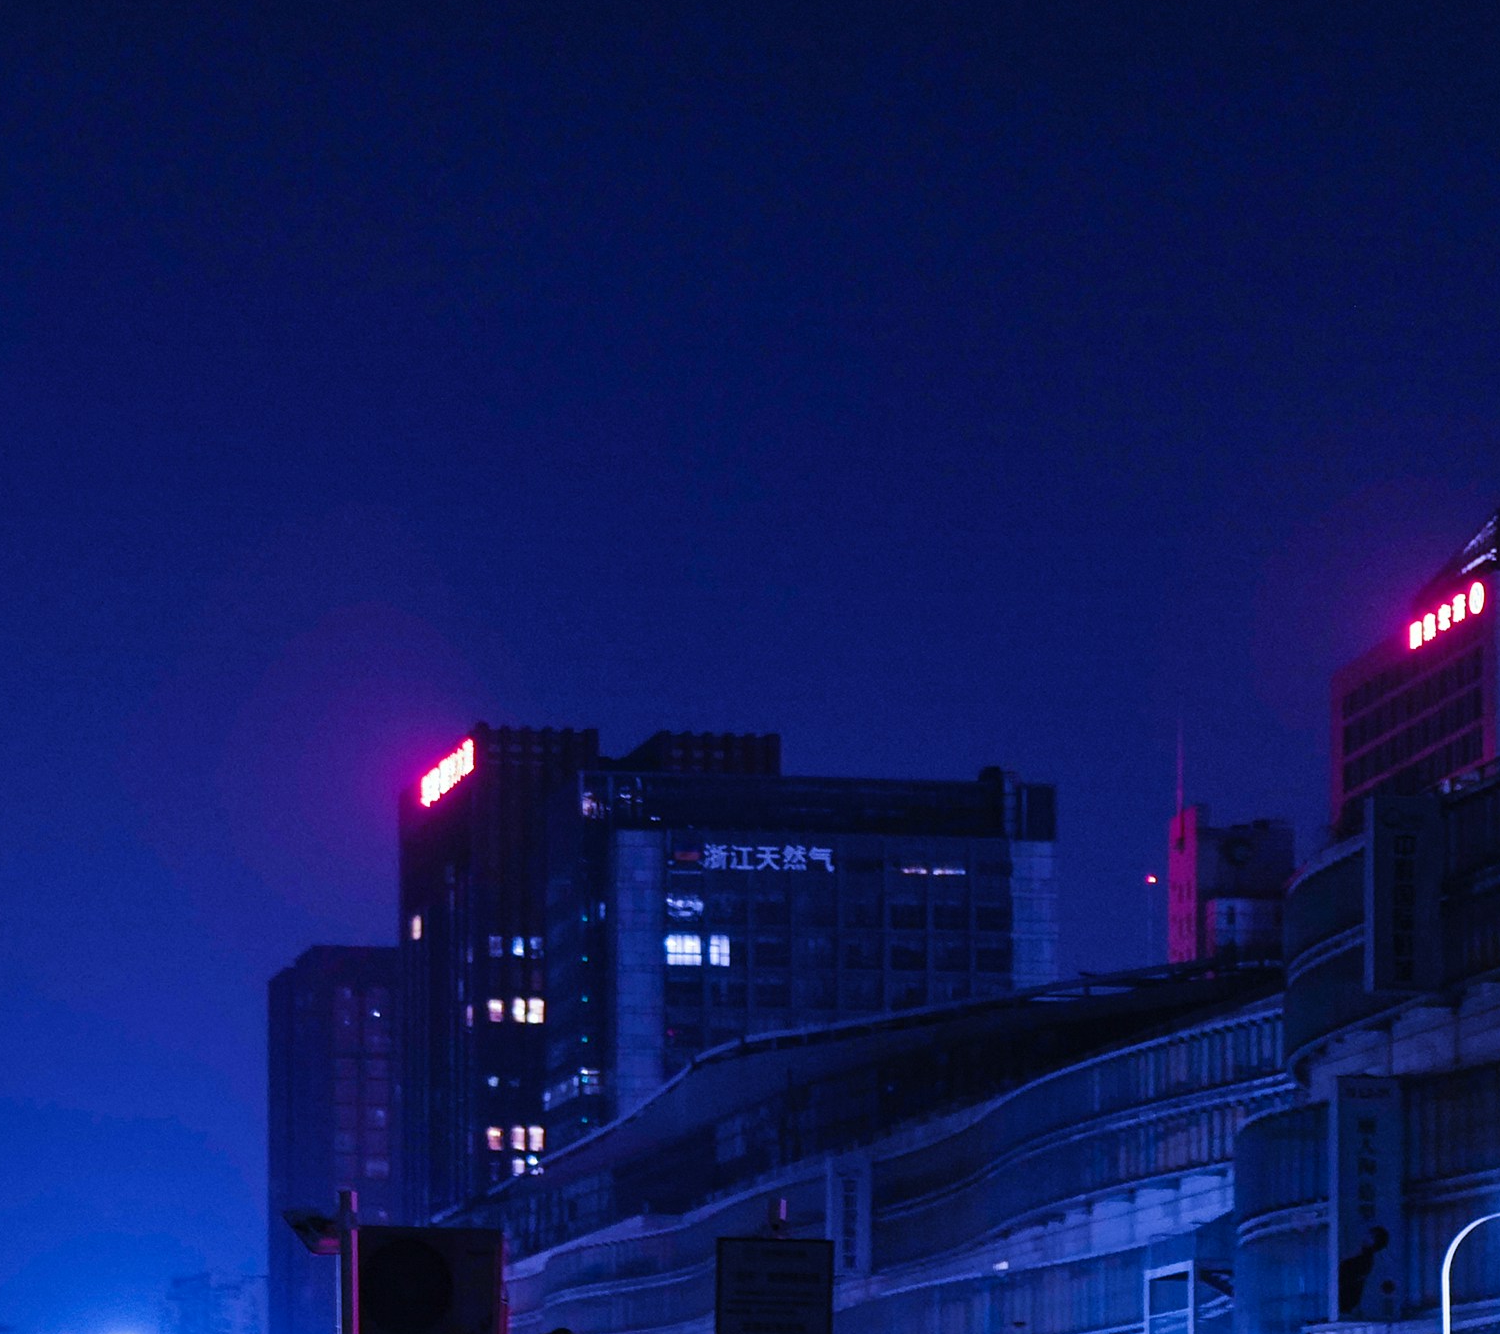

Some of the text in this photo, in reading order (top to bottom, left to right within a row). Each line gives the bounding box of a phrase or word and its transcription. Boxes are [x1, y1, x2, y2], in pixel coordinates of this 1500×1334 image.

[703, 843, 835, 873] 浙江天然气
